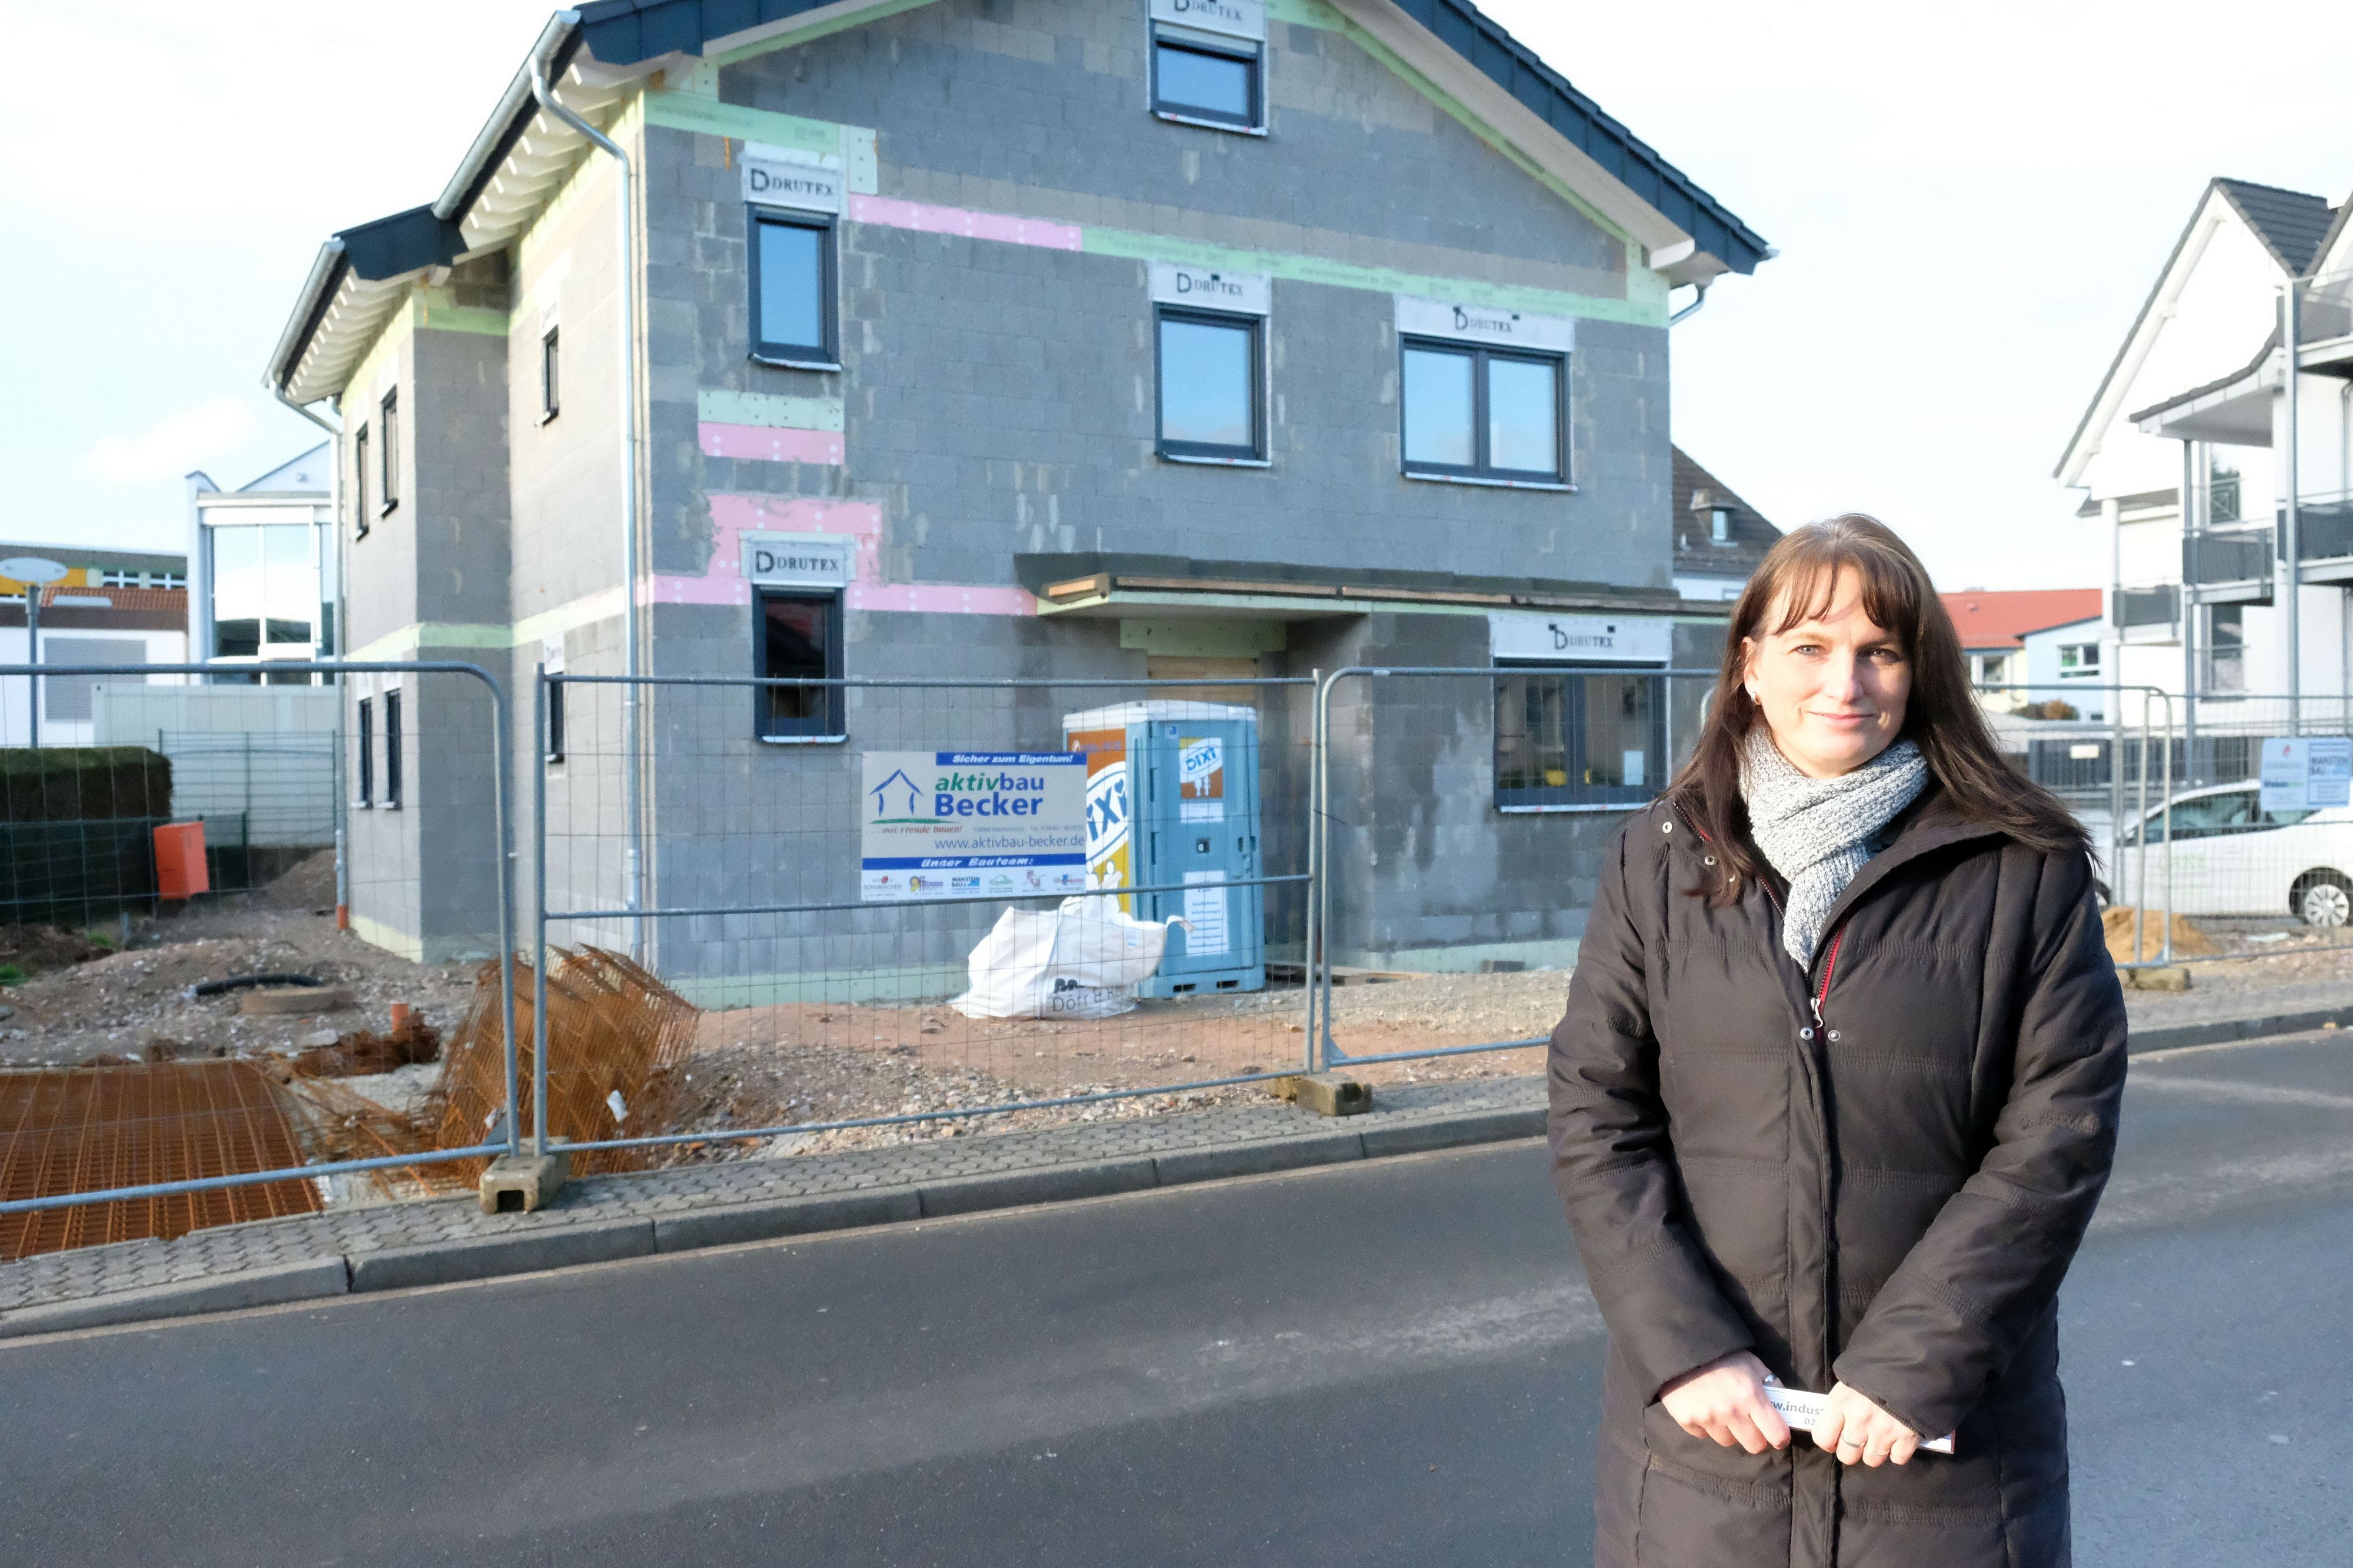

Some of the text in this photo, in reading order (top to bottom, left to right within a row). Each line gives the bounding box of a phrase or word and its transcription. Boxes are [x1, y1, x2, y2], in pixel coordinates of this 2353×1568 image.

[952, 755, 991, 763] Sicher
[1018, 755, 1074, 764] Eigentum!
[935, 772, 1044, 792] aktivbau
[934, 792, 1044, 818] Becker
[934, 835, 1085, 849] www.aktivbau-becker.de
[921, 858, 1034, 868] Unser Bauteam:
[1770, 1401, 1824, 1416] w.indus
